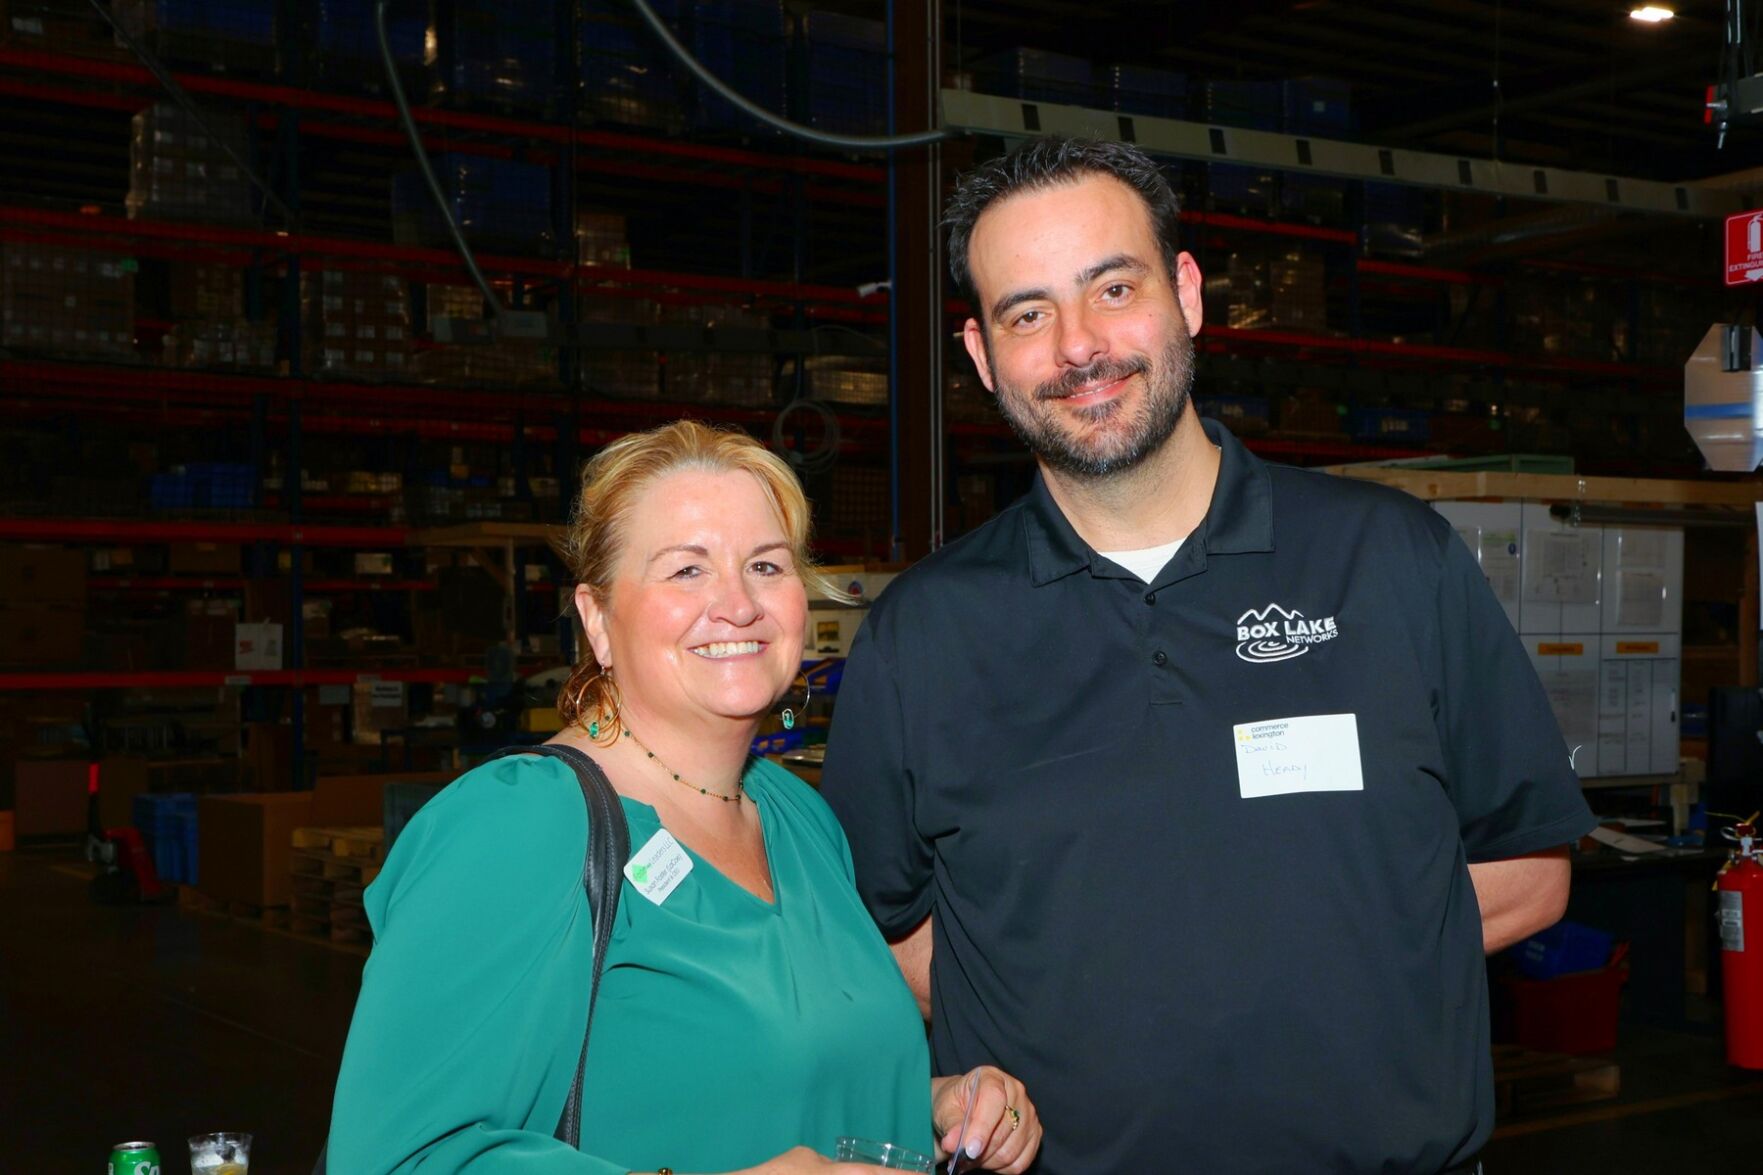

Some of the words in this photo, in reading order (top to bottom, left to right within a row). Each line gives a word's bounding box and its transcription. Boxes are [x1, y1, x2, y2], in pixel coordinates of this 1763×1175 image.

[1236, 621, 1280, 641] BOX
[1284, 616, 1338, 636] LAKE
[1286, 629, 1339, 645] NETWORKS
[1251, 722, 1289, 733] commerce
